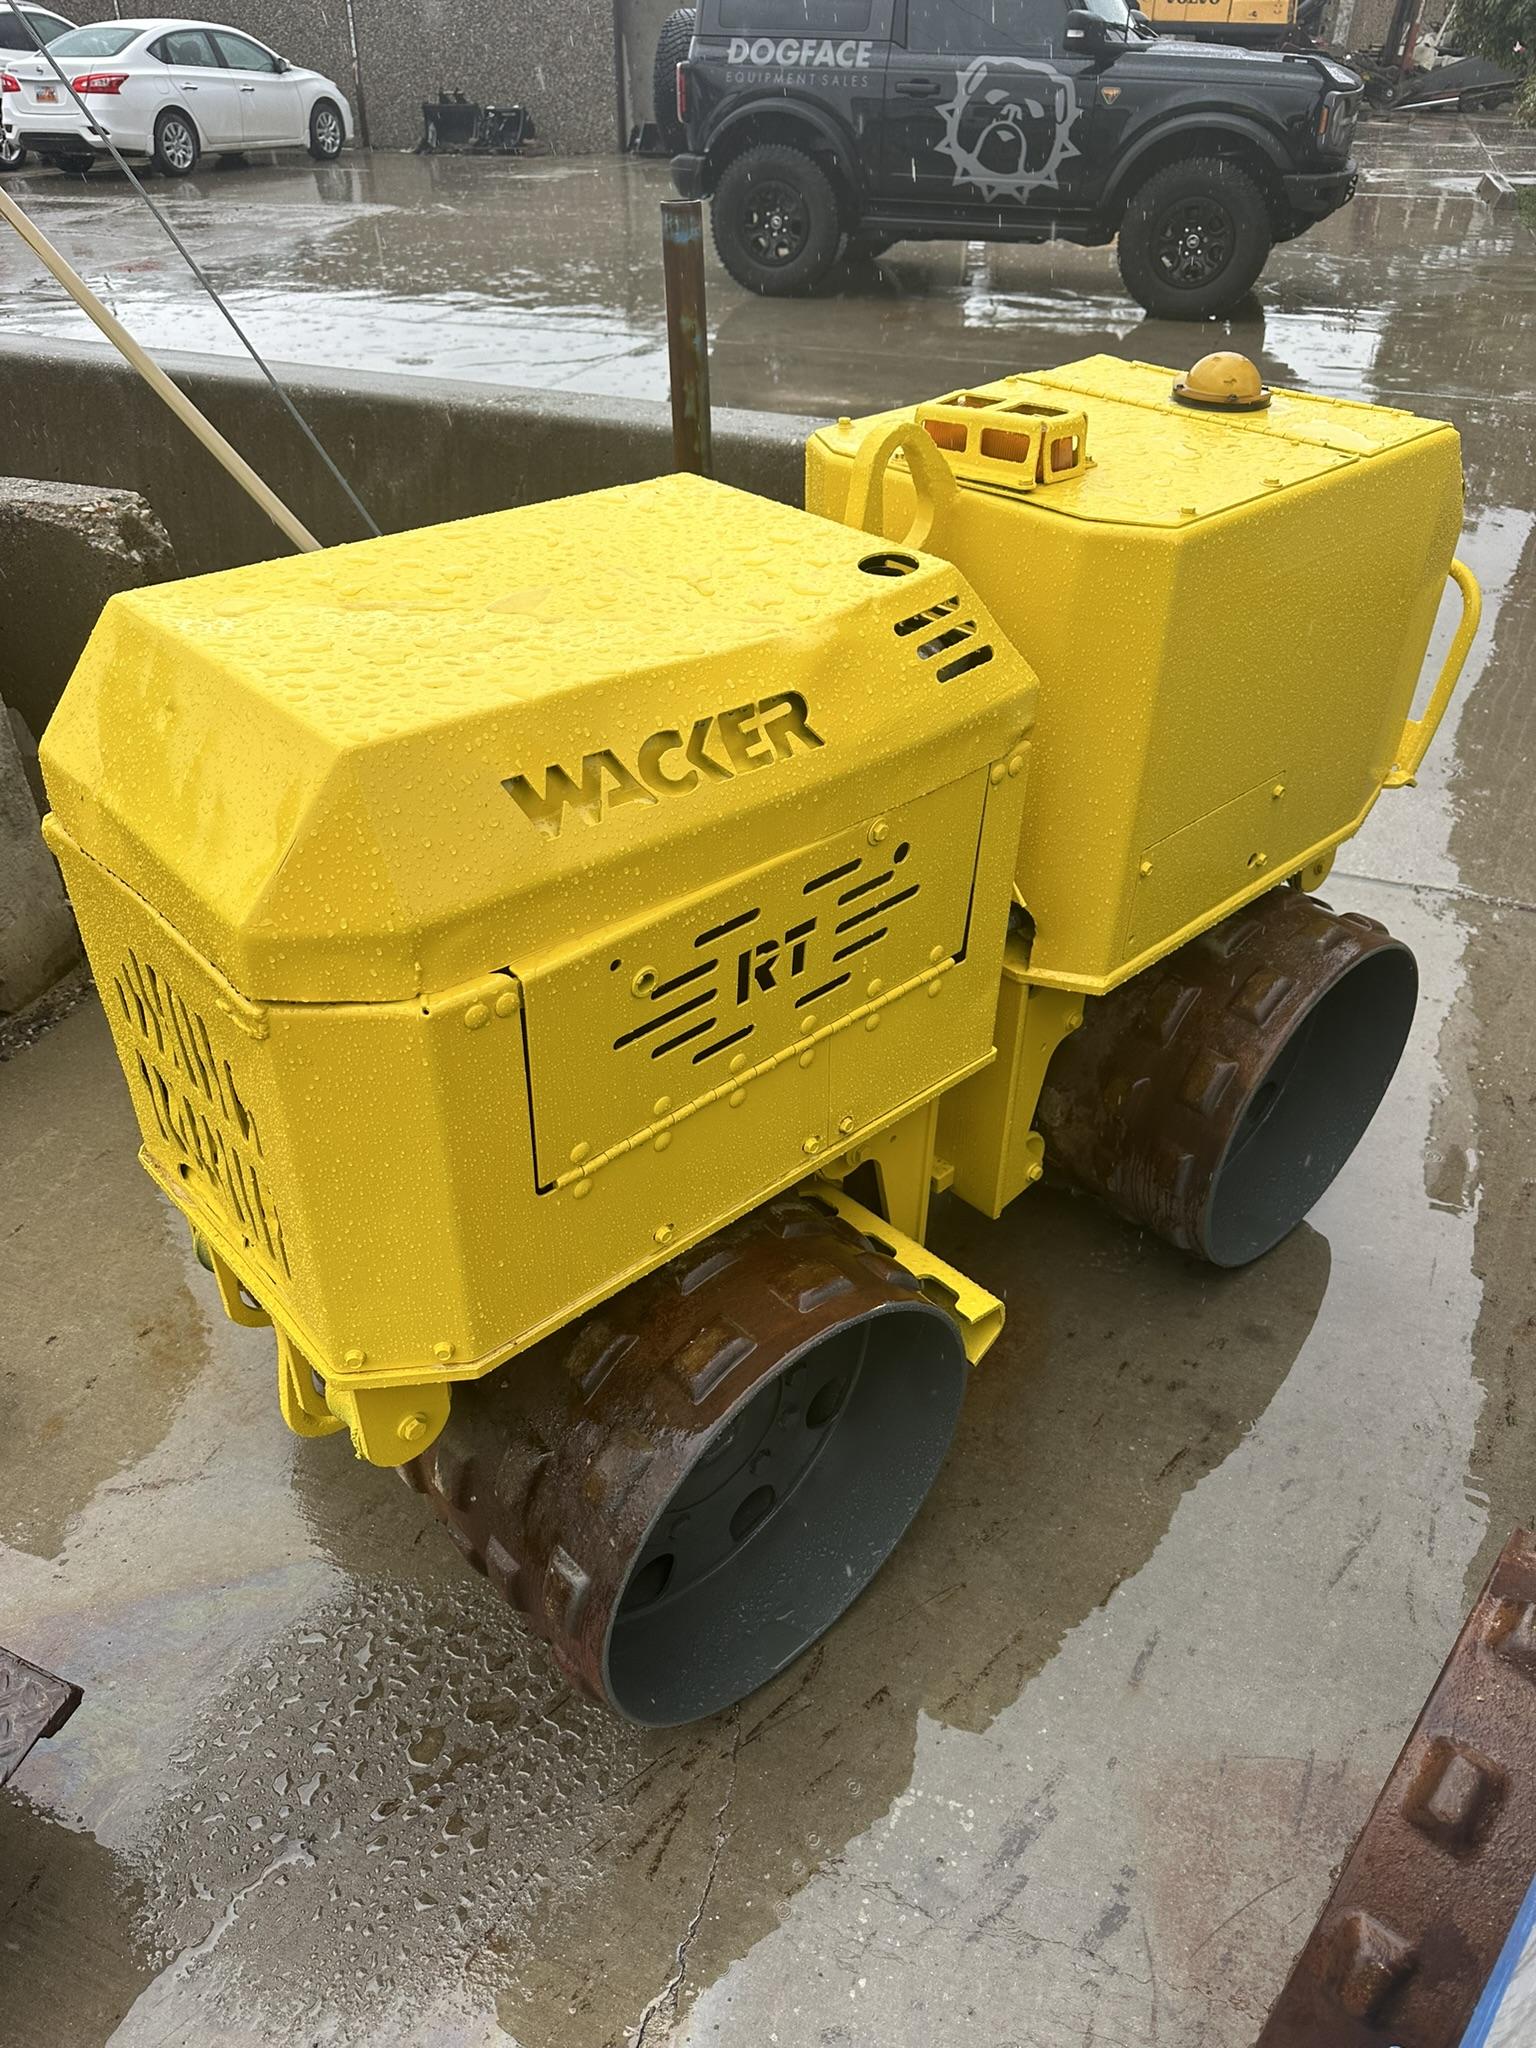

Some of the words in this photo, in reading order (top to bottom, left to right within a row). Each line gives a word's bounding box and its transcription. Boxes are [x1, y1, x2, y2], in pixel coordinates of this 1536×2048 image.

[725, 71, 815, 85] EQUIPMENT
[821, 74, 868, 87] SALES
[727, 37, 873, 68] DOGFACE
[500, 690, 826, 841] WACKER
[736, 916, 818, 1006] RT
